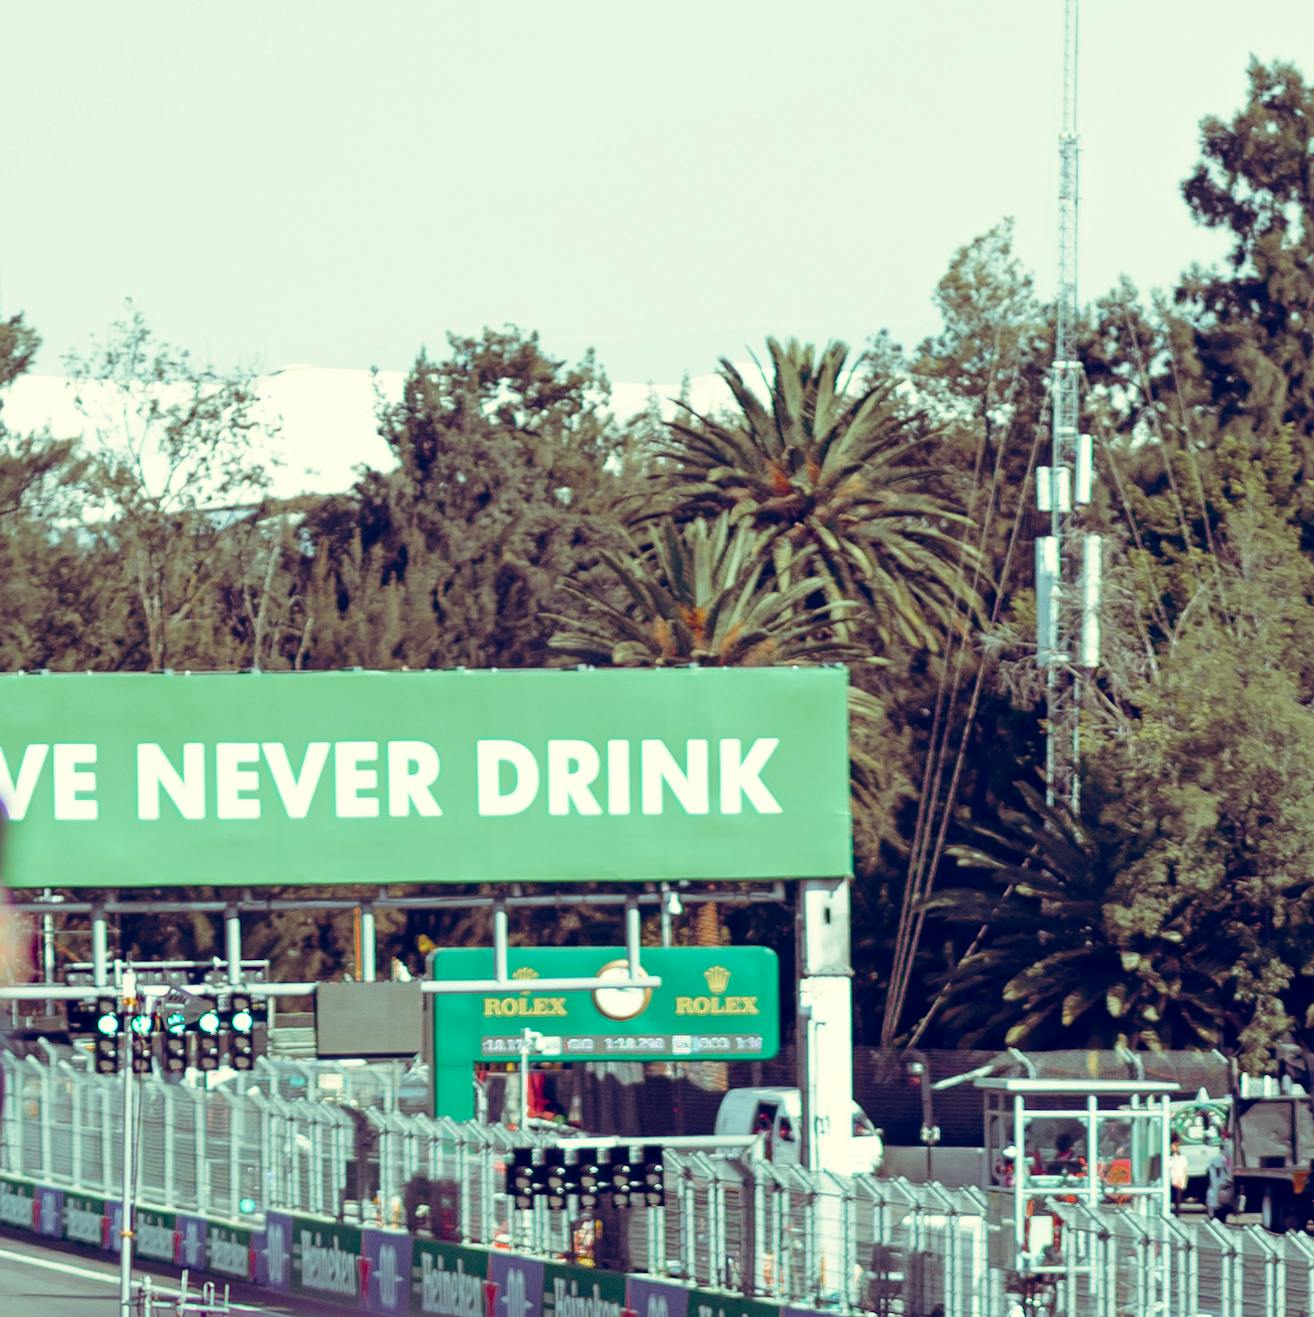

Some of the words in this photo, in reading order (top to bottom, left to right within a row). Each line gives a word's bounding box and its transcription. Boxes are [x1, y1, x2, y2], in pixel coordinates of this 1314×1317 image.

[0, 744, 98, 820] VE
[137, 741, 444, 820] NEVER
[477, 737, 784, 816] DRINK
[483, 998, 568, 1017] ROLEX
[675, 996, 760, 1016] ROLEX
